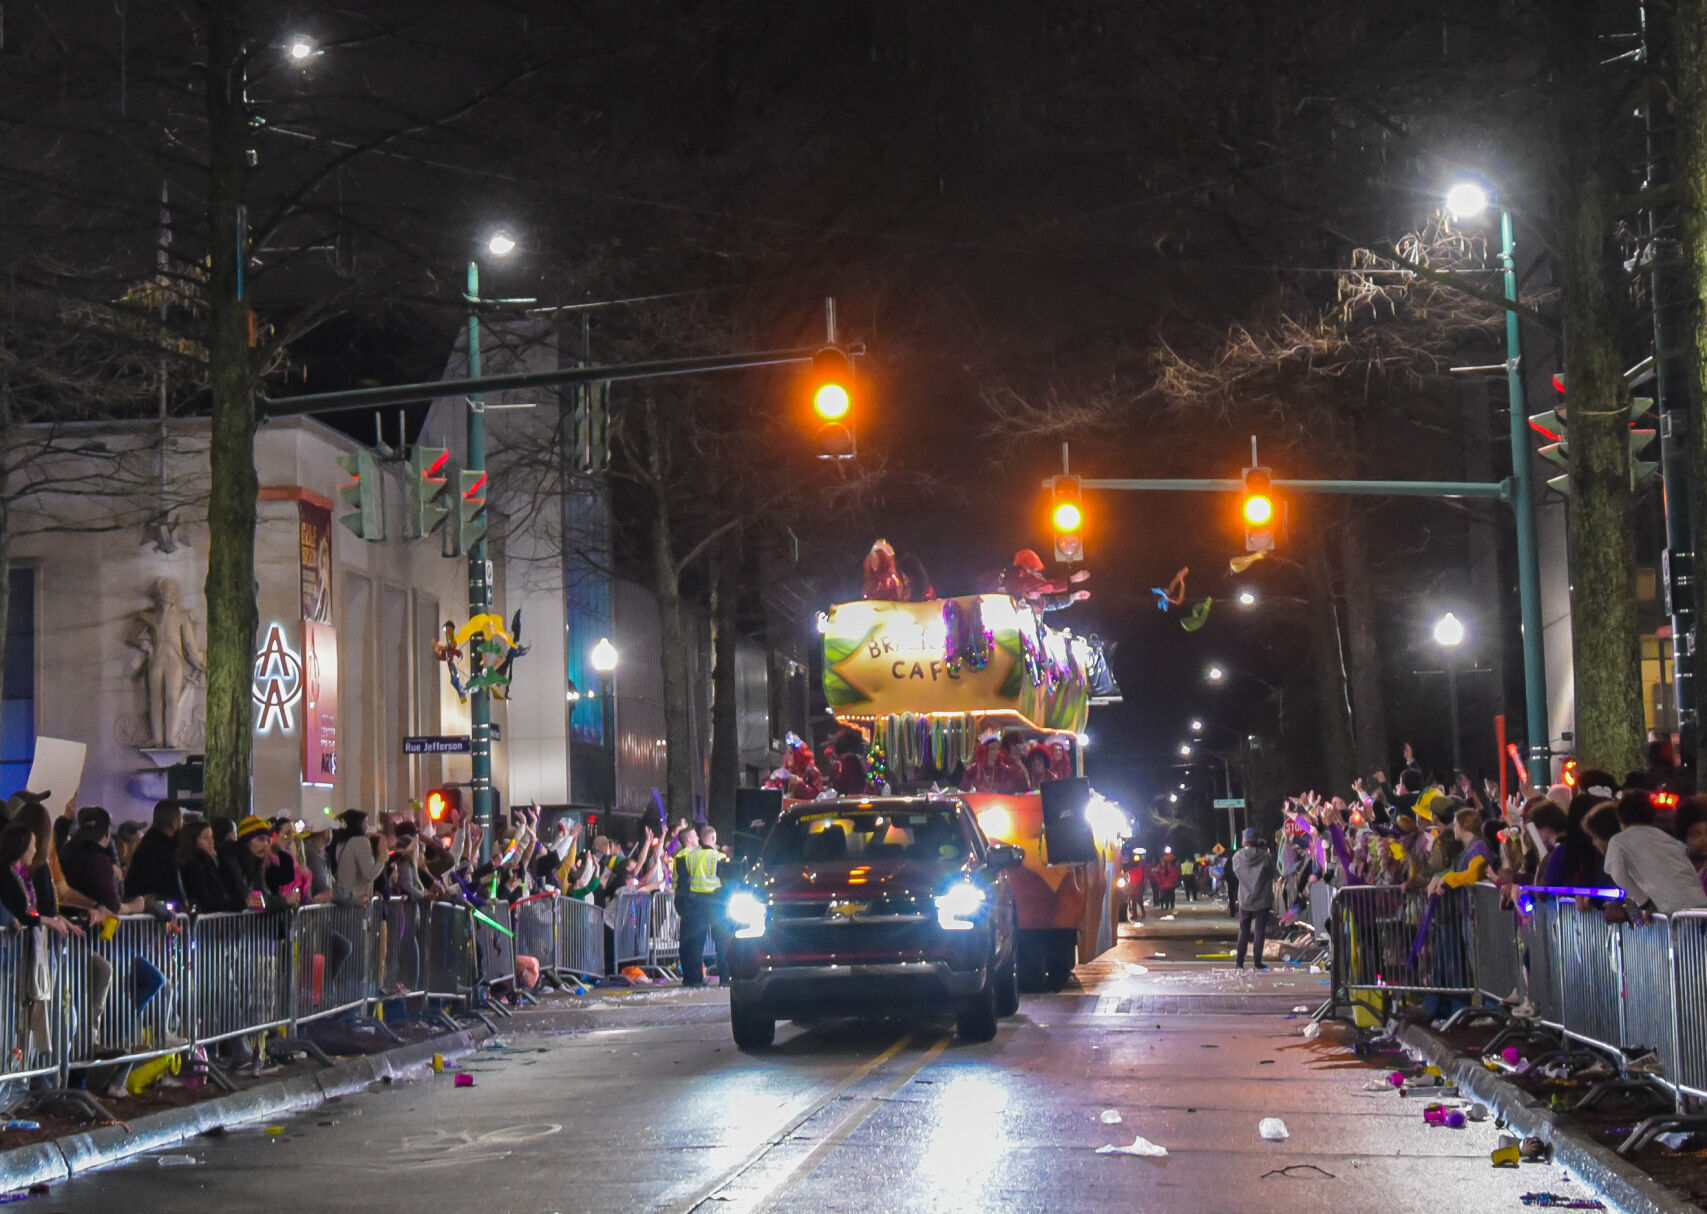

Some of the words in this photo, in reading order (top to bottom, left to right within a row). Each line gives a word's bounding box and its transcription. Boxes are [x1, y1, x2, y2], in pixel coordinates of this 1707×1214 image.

[405, 743, 421, 752] Rue
[423, 742, 463, 752] Jefferson
[1285, 823, 1302, 833] STO
